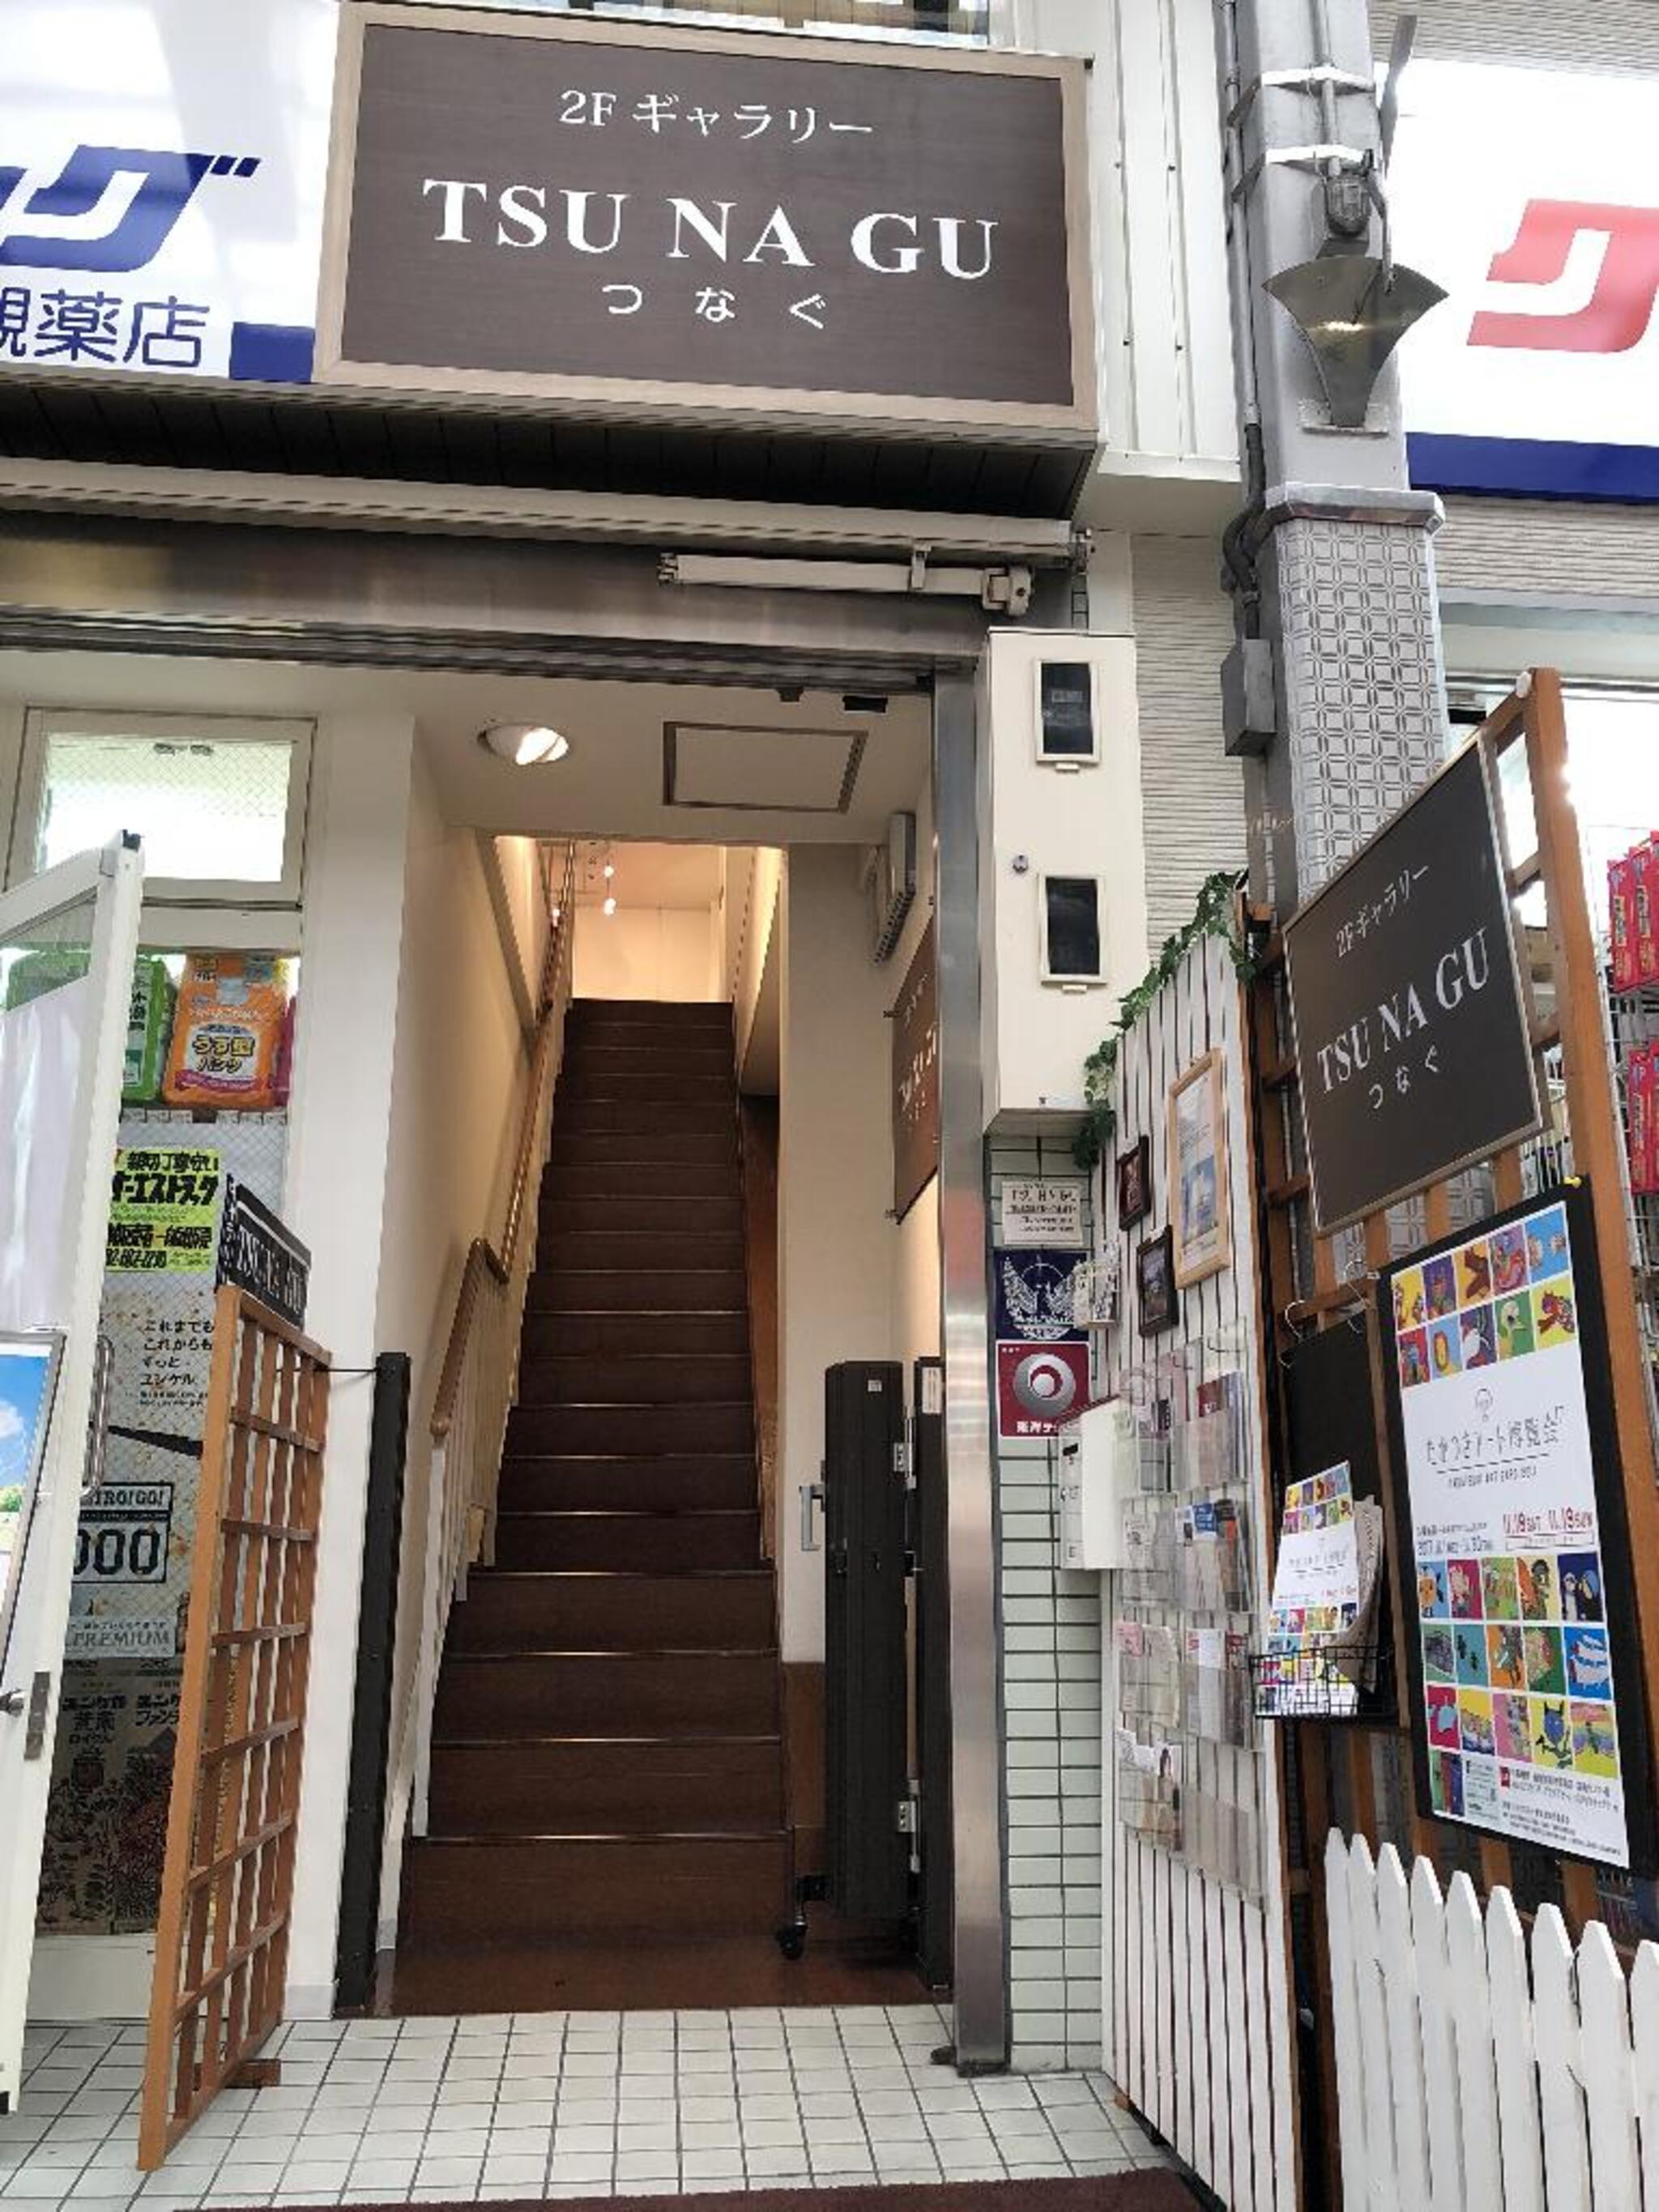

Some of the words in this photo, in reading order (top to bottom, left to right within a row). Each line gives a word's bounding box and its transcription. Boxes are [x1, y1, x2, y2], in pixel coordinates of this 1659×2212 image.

[560, 90, 617, 127] 2F
[632, 93, 872, 144] ギャラリー
[422, 178, 632, 254] TSU
[665, 197, 816, 267] NA
[851, 212, 999, 280] GU
[1316, 1017, 1371, 1094] TSU
[1378, 984, 1428, 1052] NA
[1435, 929, 1489, 1011] GU
[144, 1319, 215, 1333] これまでも
[144, 1338, 213, 1351] これからも
[140, 1373, 196, 1386] ユンケル
